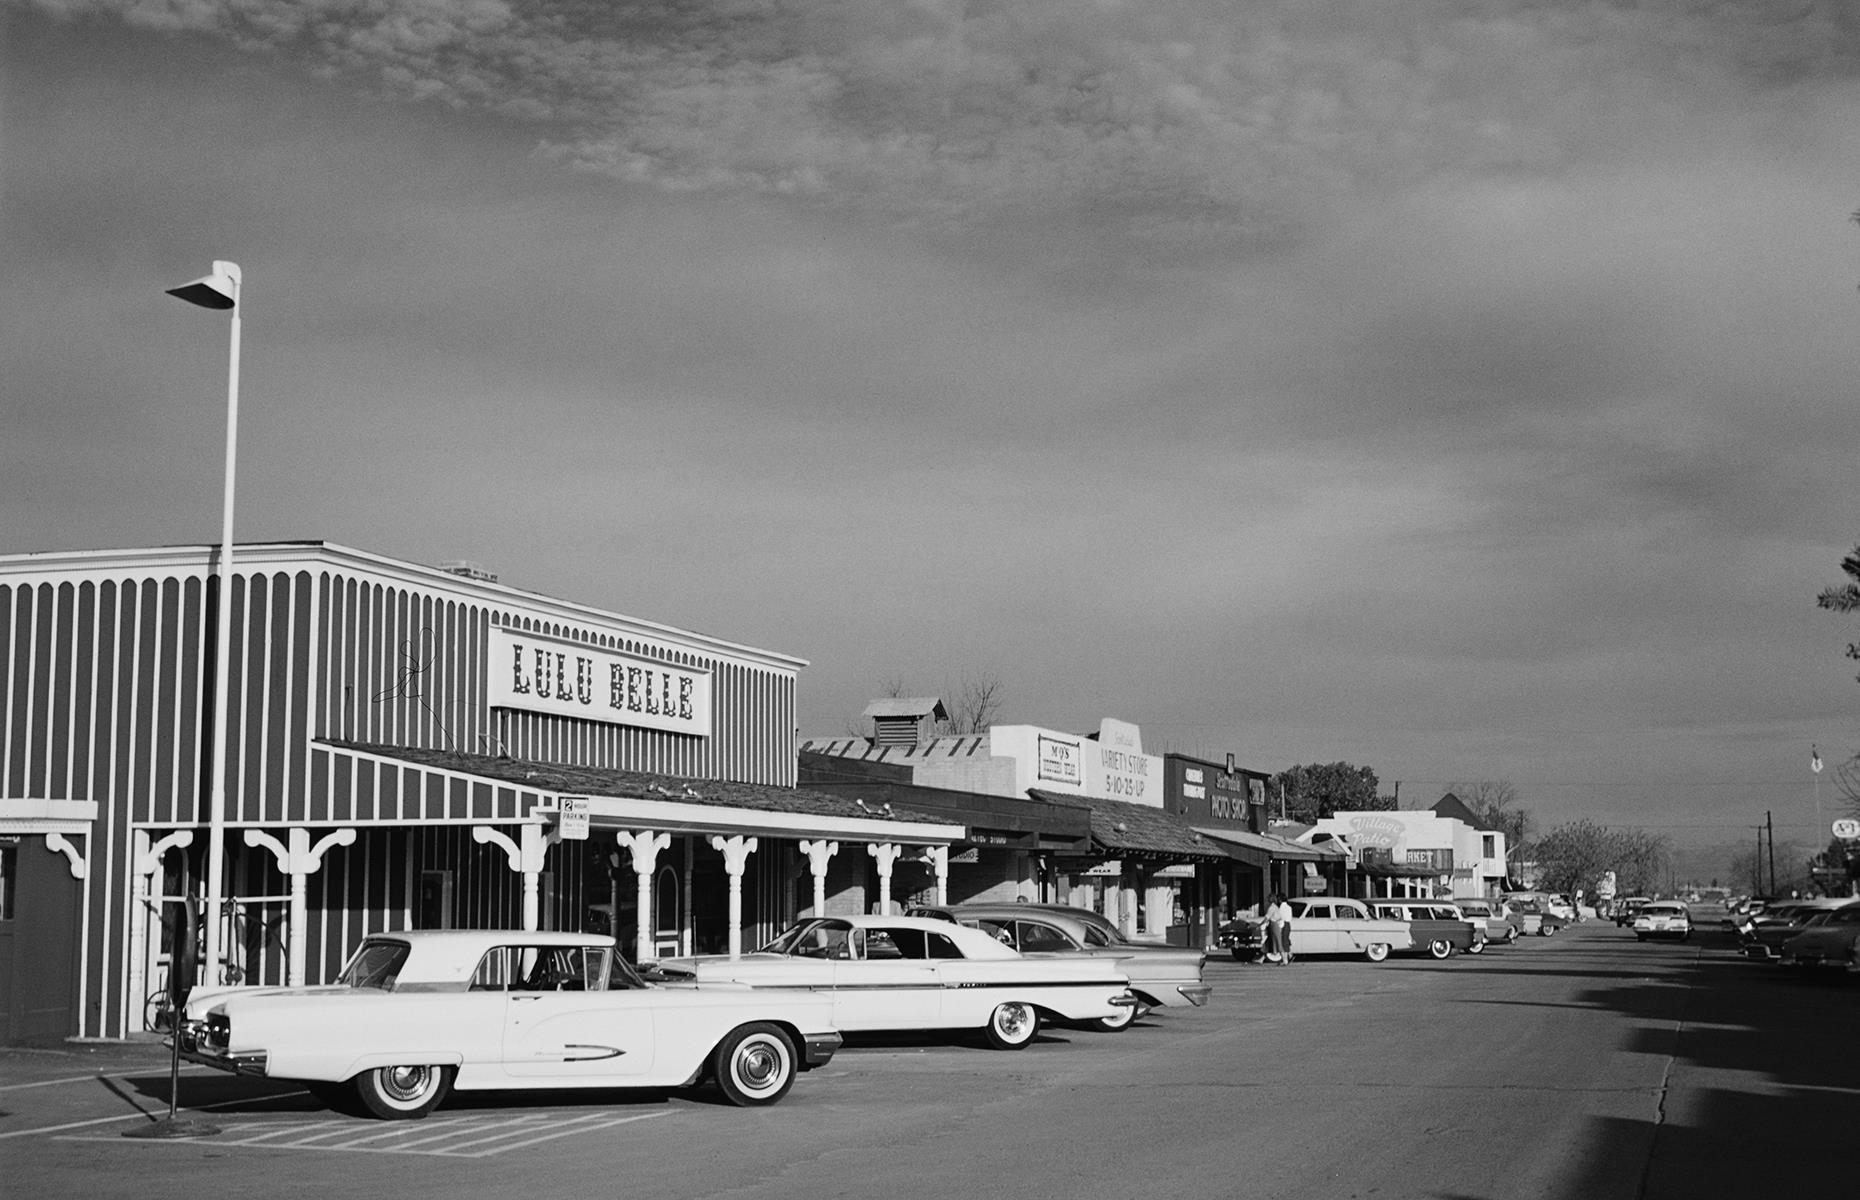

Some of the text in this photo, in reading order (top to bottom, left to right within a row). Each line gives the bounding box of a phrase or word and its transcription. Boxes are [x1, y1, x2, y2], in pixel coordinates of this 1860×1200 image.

[513, 644, 693, 720] LULU BELLE
[1101, 747, 1149, 777] VARIETY STORE
[1353, 817, 1401, 834] Village
[1352, 833, 1391, 846] Patio
